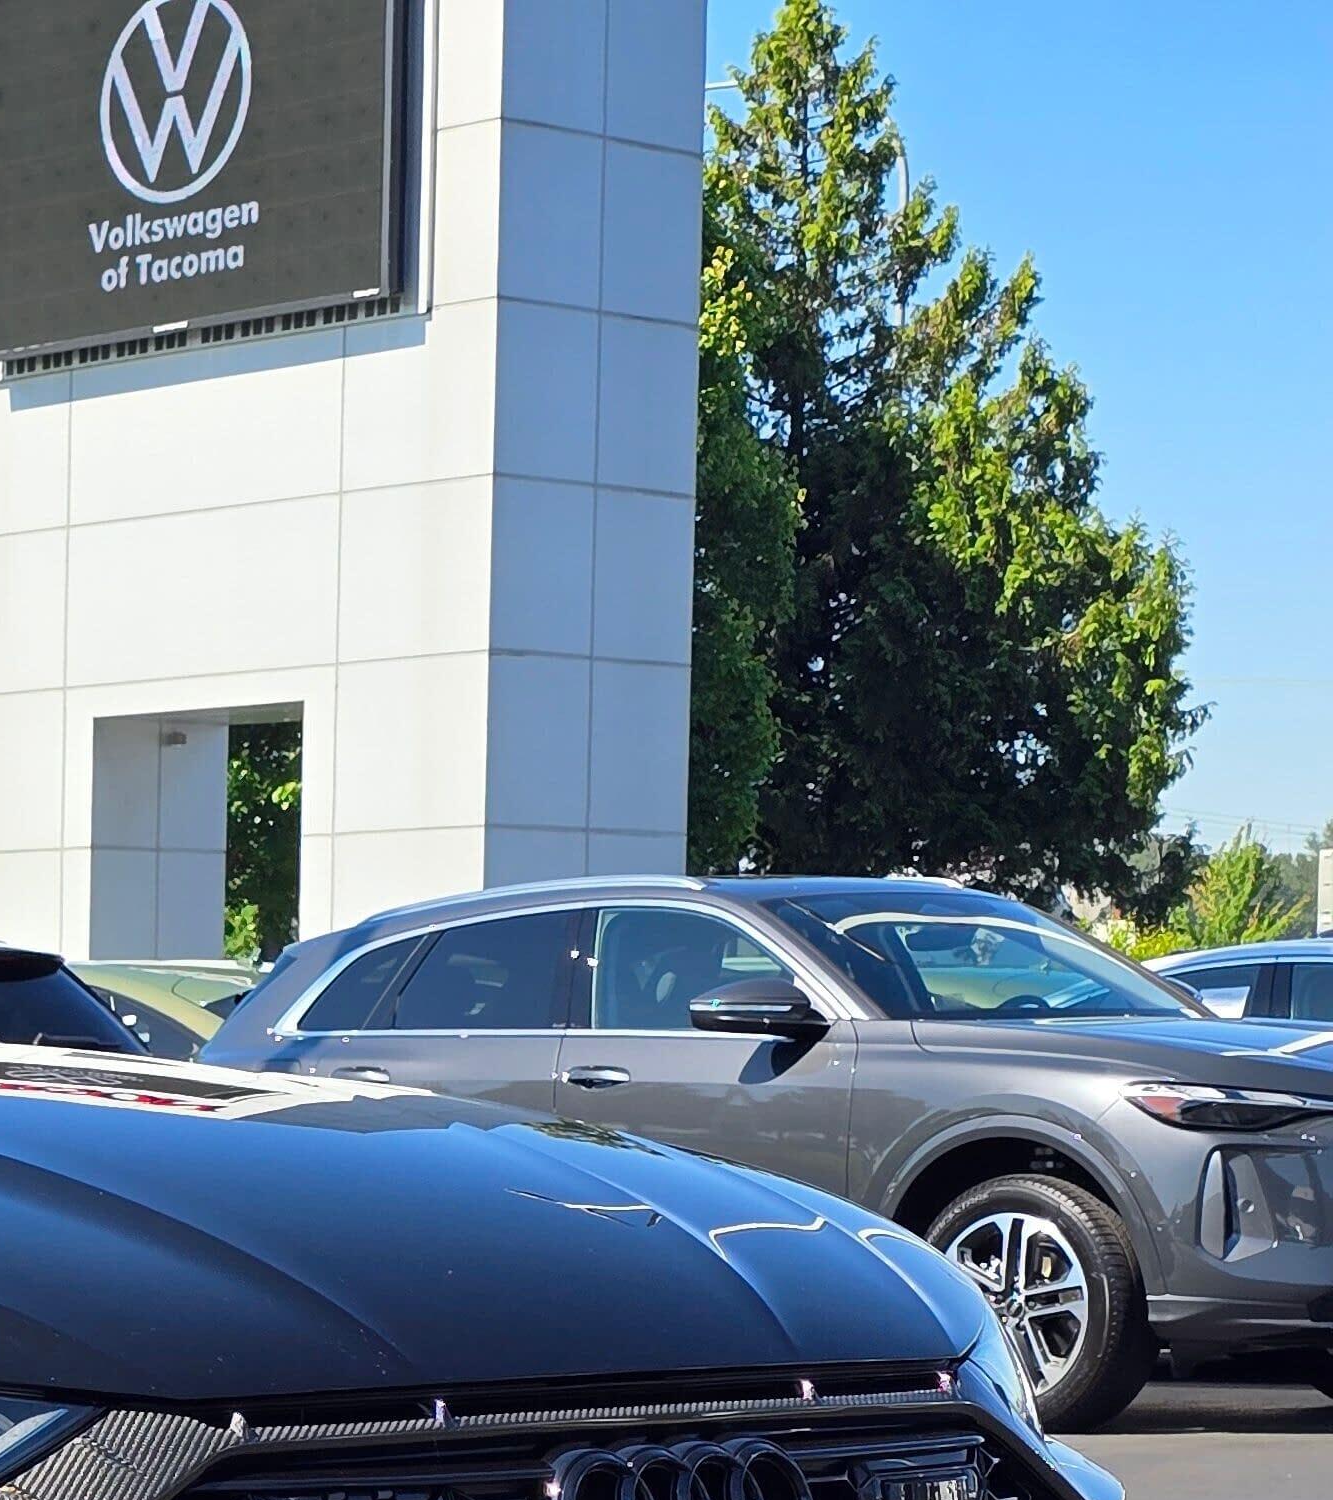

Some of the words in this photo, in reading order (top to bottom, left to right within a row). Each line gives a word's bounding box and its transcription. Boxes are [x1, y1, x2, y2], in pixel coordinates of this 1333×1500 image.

[88, 201, 259, 254] Volkswagen
[101, 255, 130, 293] of
[135, 244, 245, 285] Tacoma
